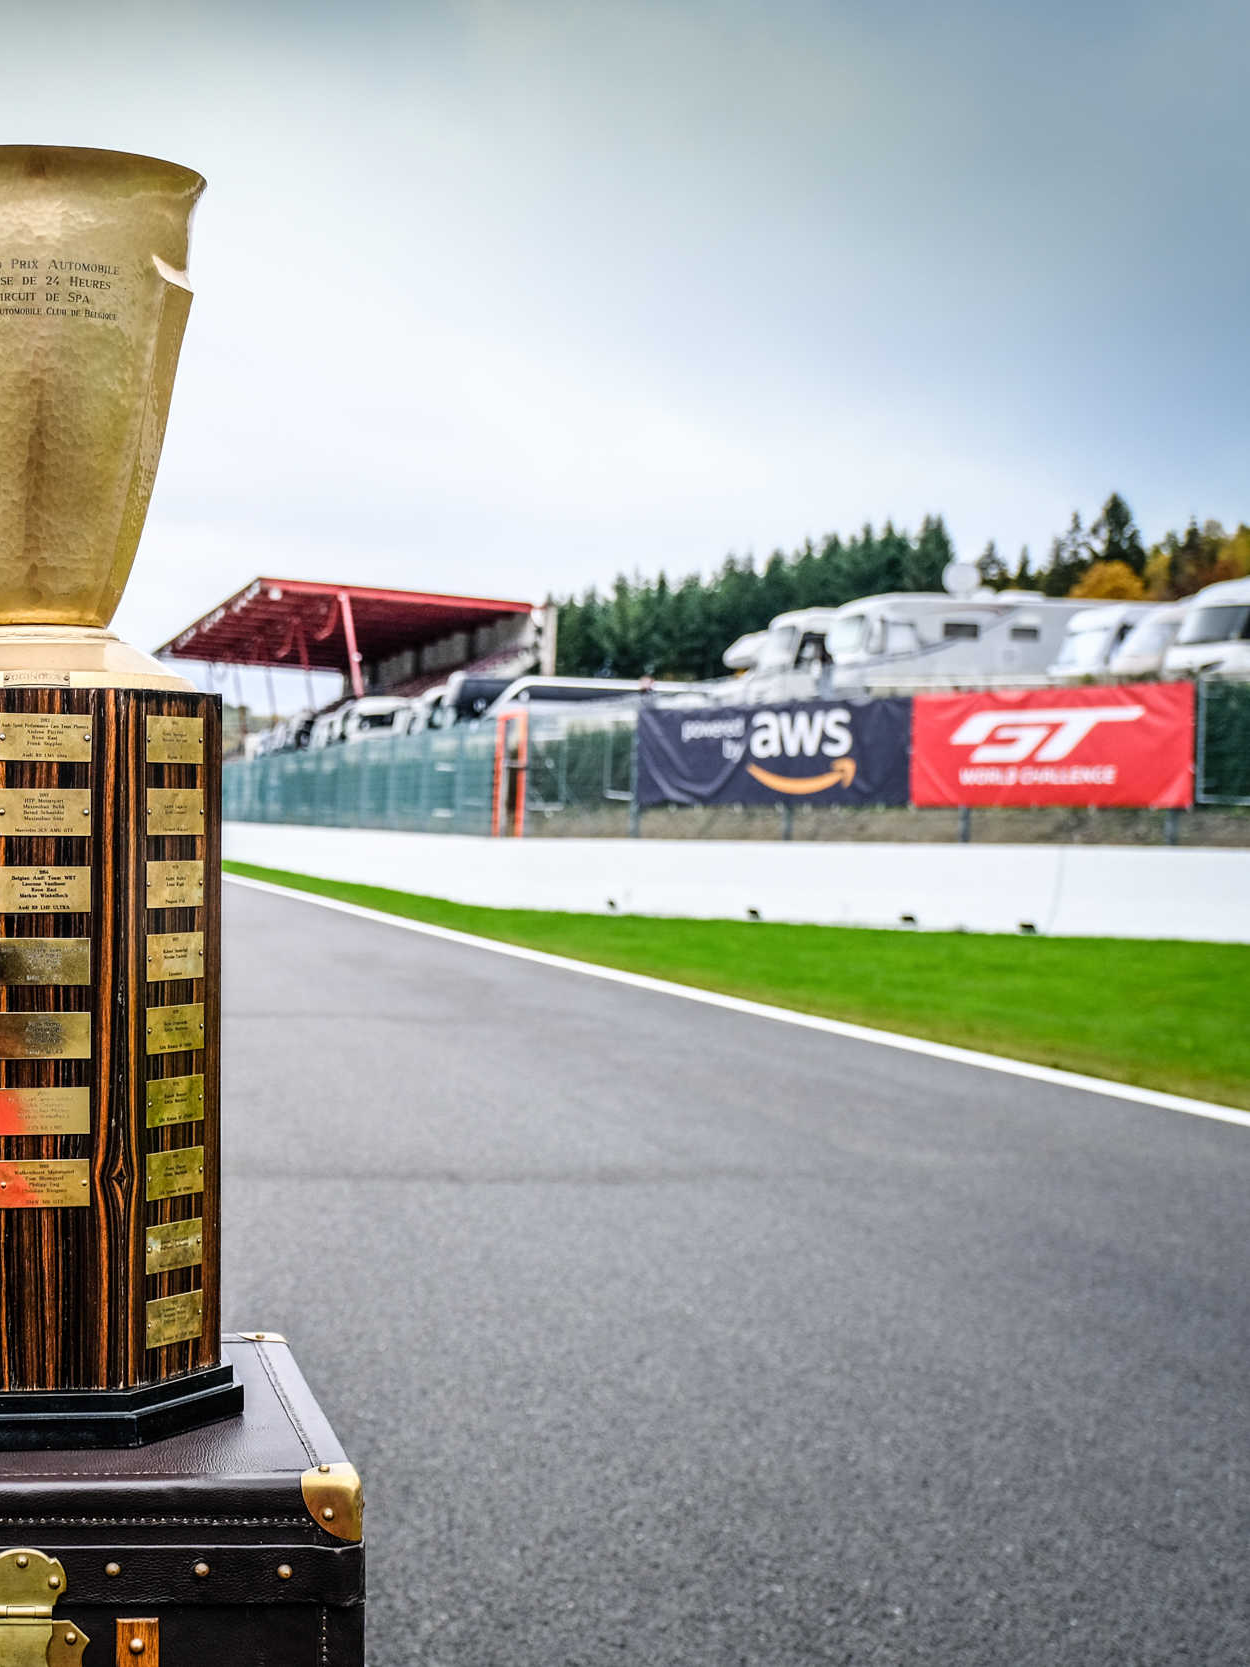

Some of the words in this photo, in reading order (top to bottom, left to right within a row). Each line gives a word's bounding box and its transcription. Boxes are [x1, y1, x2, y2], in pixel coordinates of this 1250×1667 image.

[22, 276, 38, 286] DE
[45, 275, 60, 286] 24
[45, 292, 60, 302] DE
[681, 717, 746, 743] powered
[749, 708, 853, 759] aws
[949, 704, 1146, 764] GT
[722, 738, 746, 763] by
[958, 766, 1018, 786] WORLD
[1019, 764, 1117, 786] CHALLENGE
